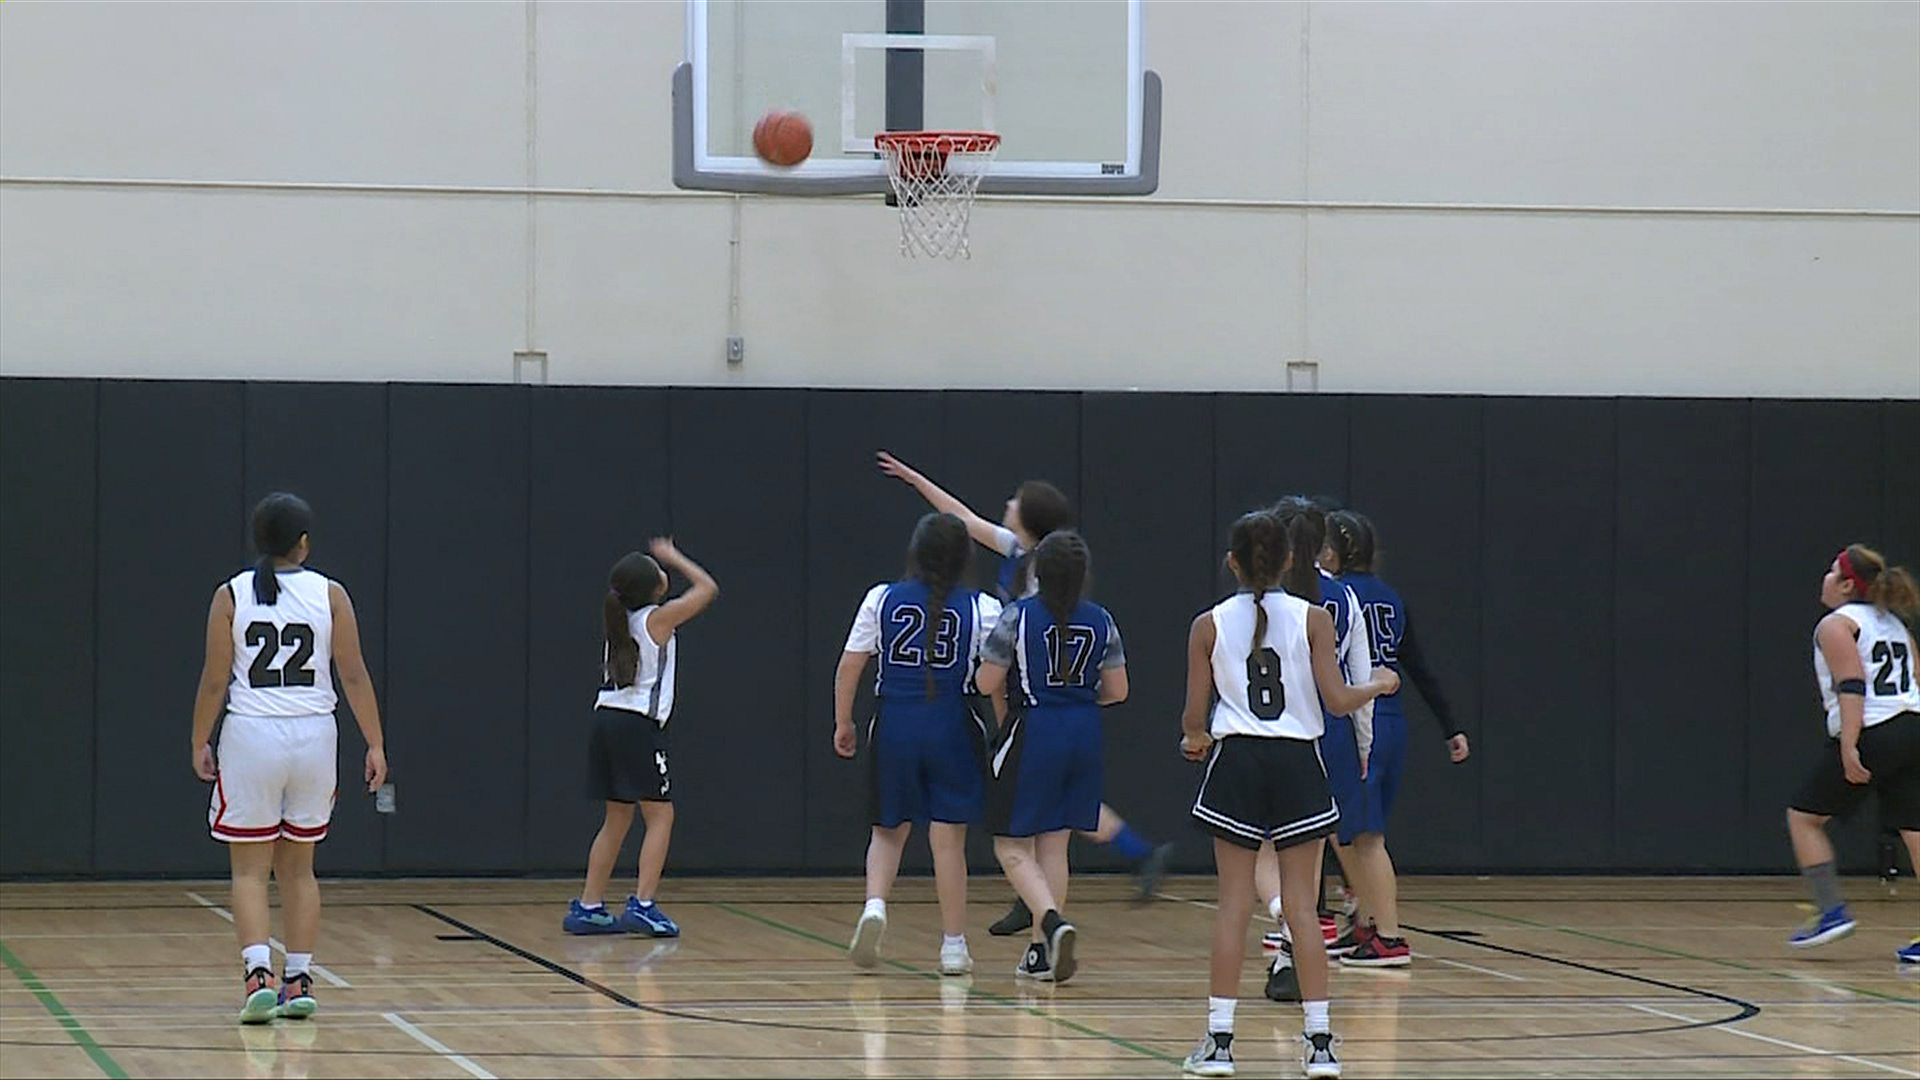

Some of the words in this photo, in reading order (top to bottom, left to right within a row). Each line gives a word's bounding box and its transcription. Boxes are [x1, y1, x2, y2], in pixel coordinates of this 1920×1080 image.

[245, 621, 315, 688] 22
[889, 605, 961, 668] 23
[1043, 625, 1096, 686] 17
[1362, 603, 1397, 662] 15
[1246, 647, 1285, 720] 8
[1872, 640, 1910, 696] 27
